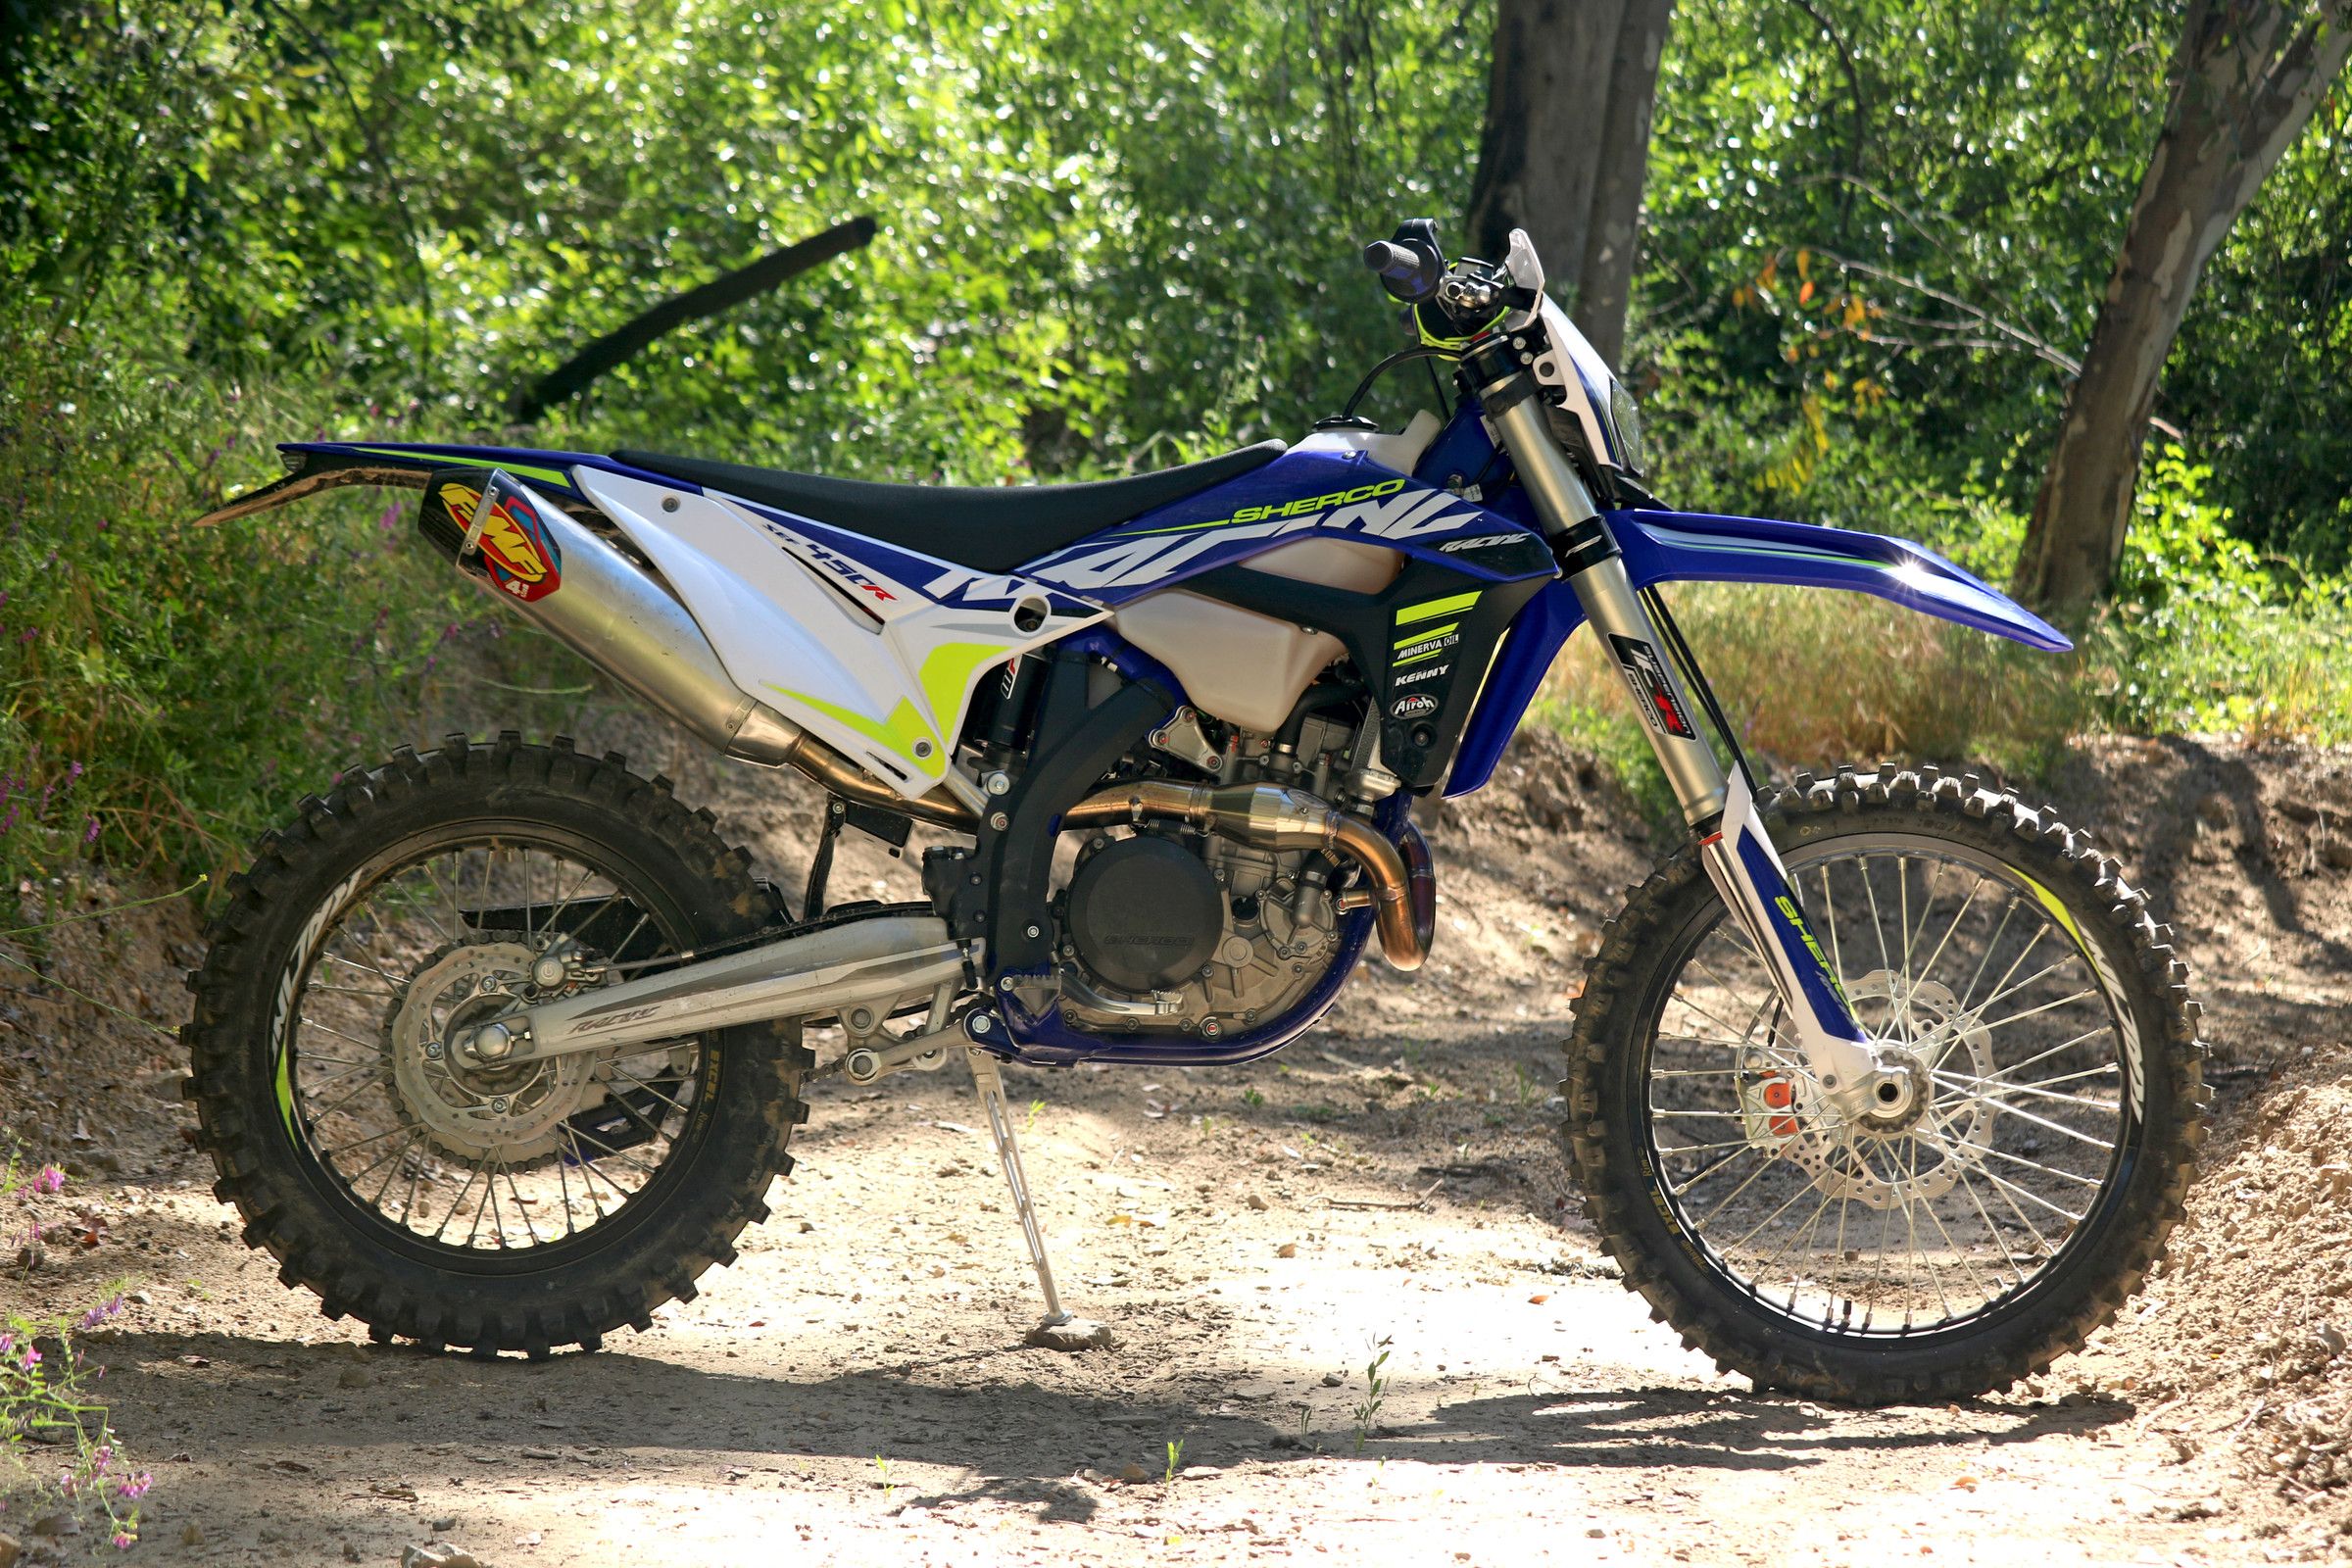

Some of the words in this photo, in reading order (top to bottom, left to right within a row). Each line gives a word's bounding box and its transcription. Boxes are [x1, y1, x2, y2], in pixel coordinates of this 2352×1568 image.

[1232, 478, 1405, 524] SHERCO
[438, 486, 548, 575] FMF
[1396, 638, 1443, 660] MINERVA
[1444, 633, 1459, 647] OIL
[1395, 663, 1449, 687] KENNY
[1394, 696, 1436, 715] Airoh
[1627, 672, 1658, 727] SHERCO
